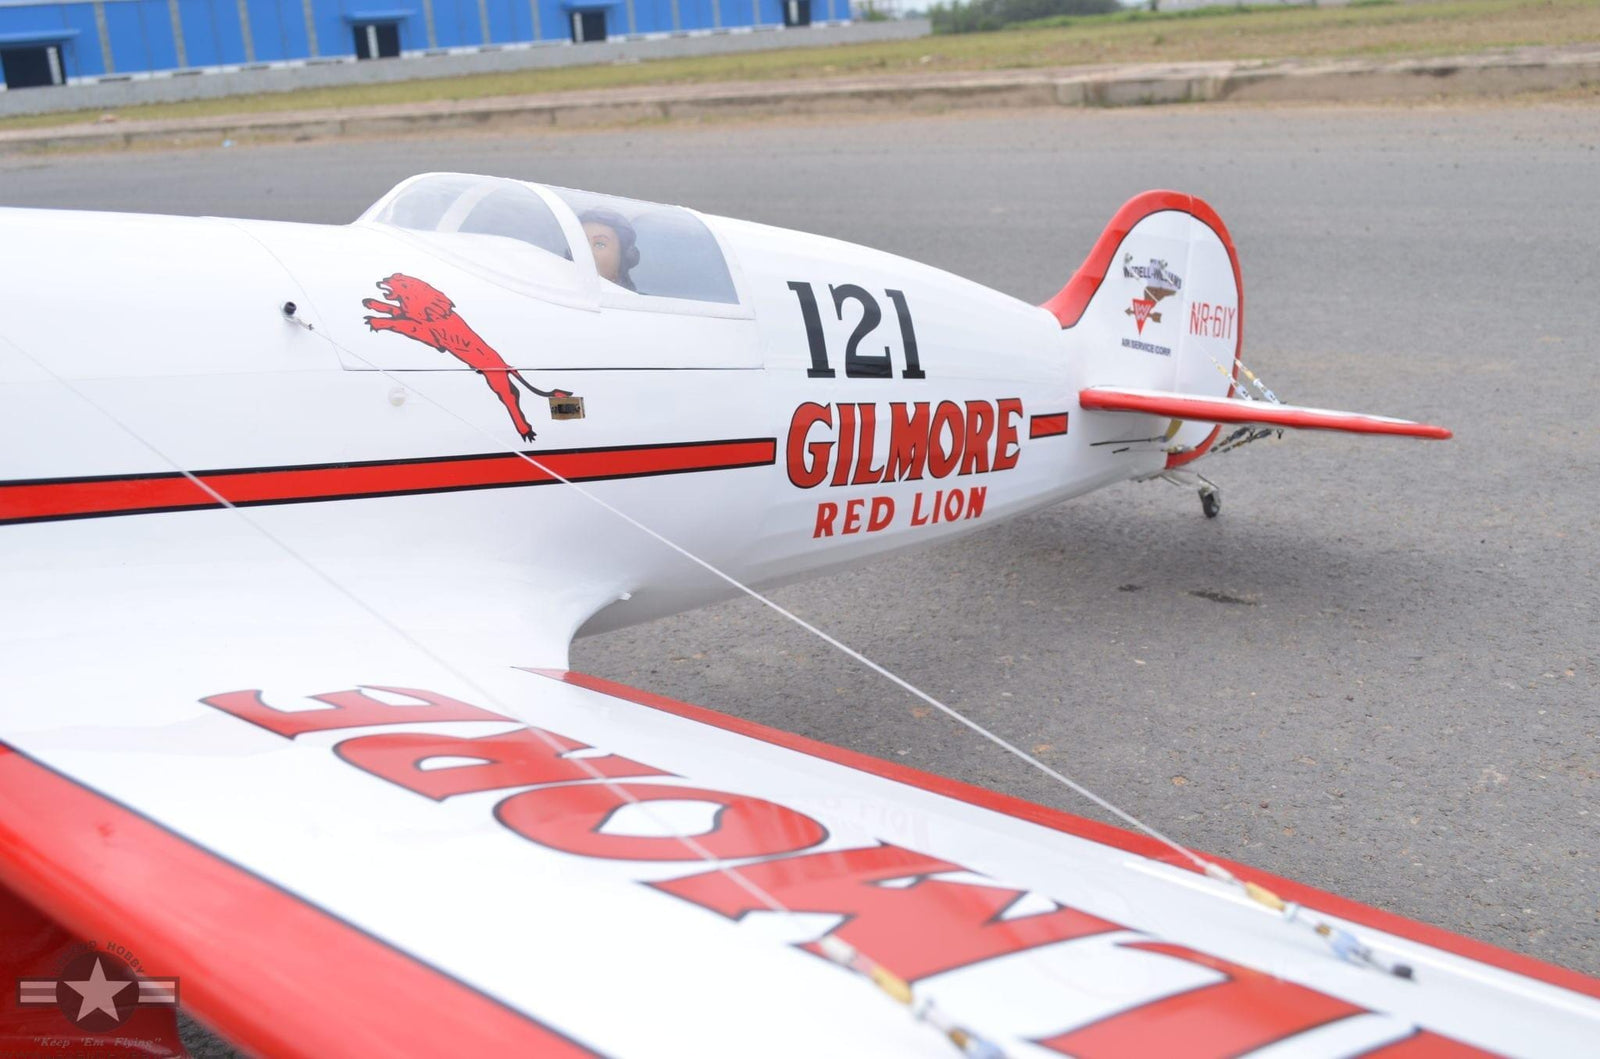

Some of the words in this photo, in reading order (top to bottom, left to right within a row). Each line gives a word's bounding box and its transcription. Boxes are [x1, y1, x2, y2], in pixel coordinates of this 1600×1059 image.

[786, 281, 926, 379] 121
[1131, 340, 1154, 354] SERVICE
[786, 397, 1023, 489] GILMORE
[812, 496, 895, 538] RED
[910, 486, 987, 526] LION
